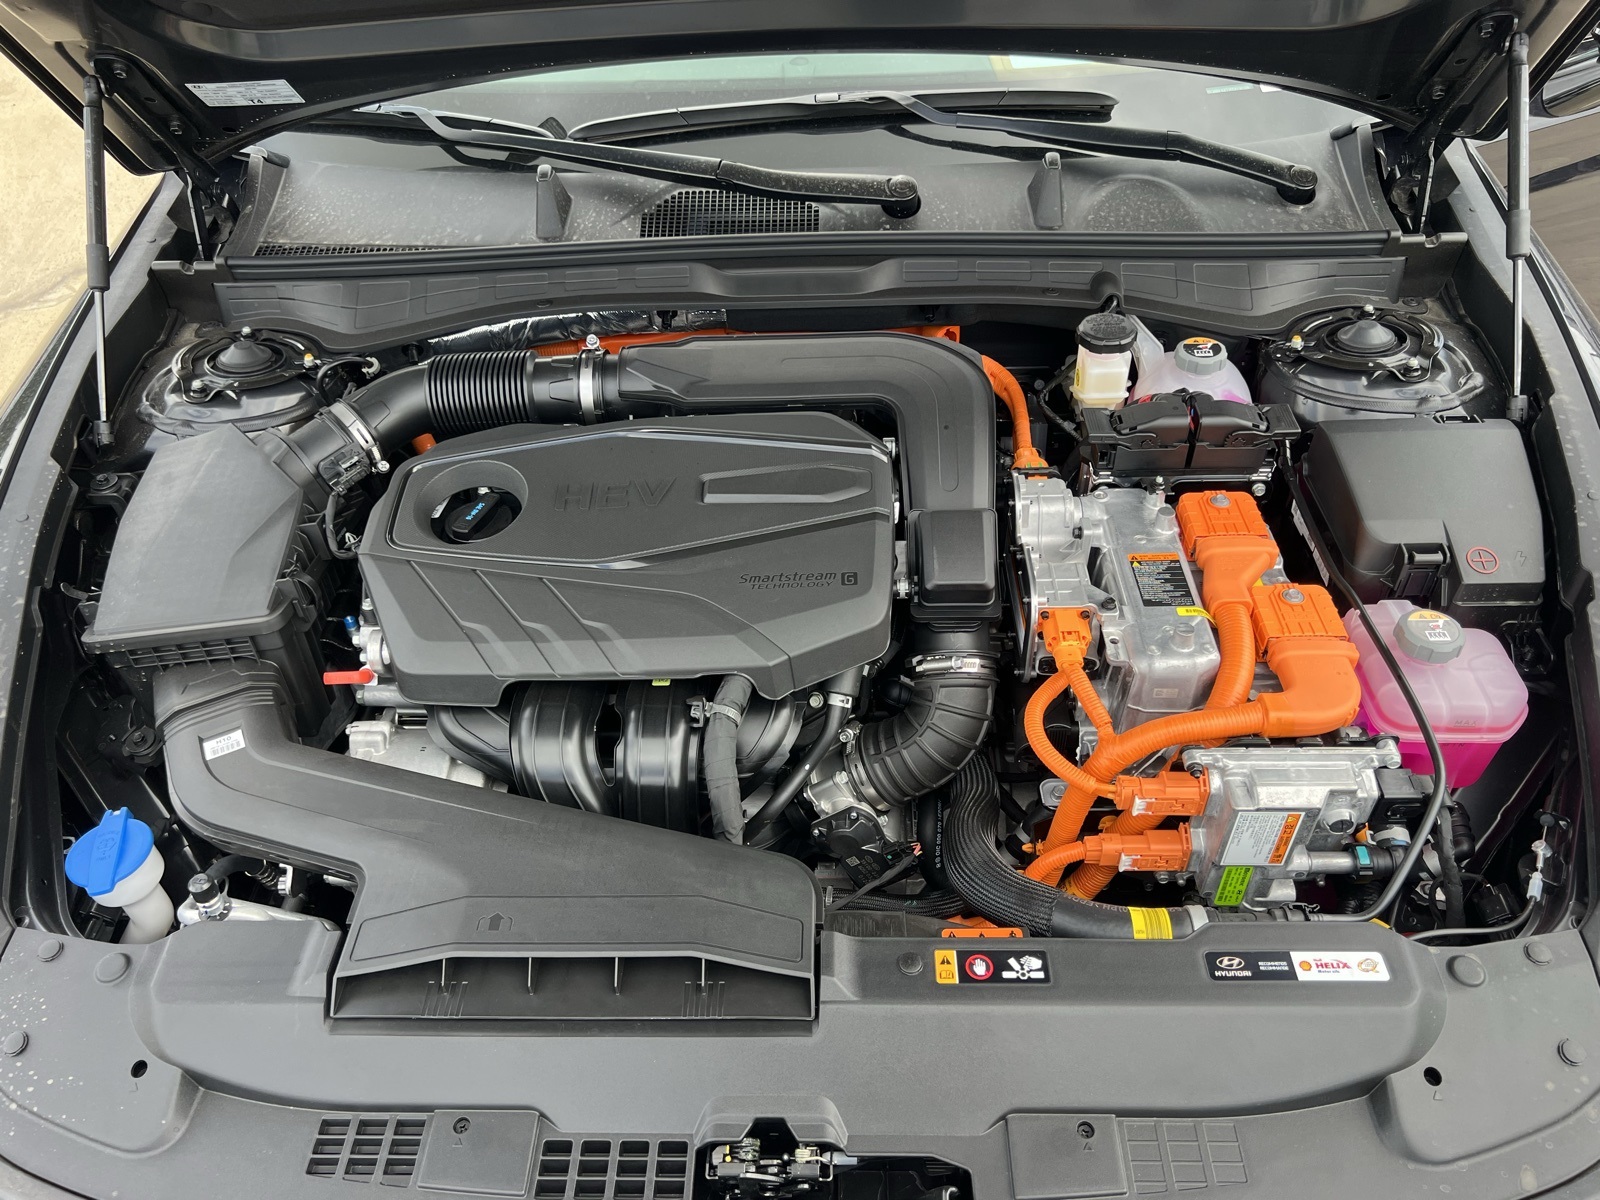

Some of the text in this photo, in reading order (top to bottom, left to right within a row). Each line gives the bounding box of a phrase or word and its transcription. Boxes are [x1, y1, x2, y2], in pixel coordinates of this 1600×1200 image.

[554, 477, 678, 512] HEV
[739, 571, 856, 585] Smartstream G
[751, 581, 834, 590] TECHNOLOGY
